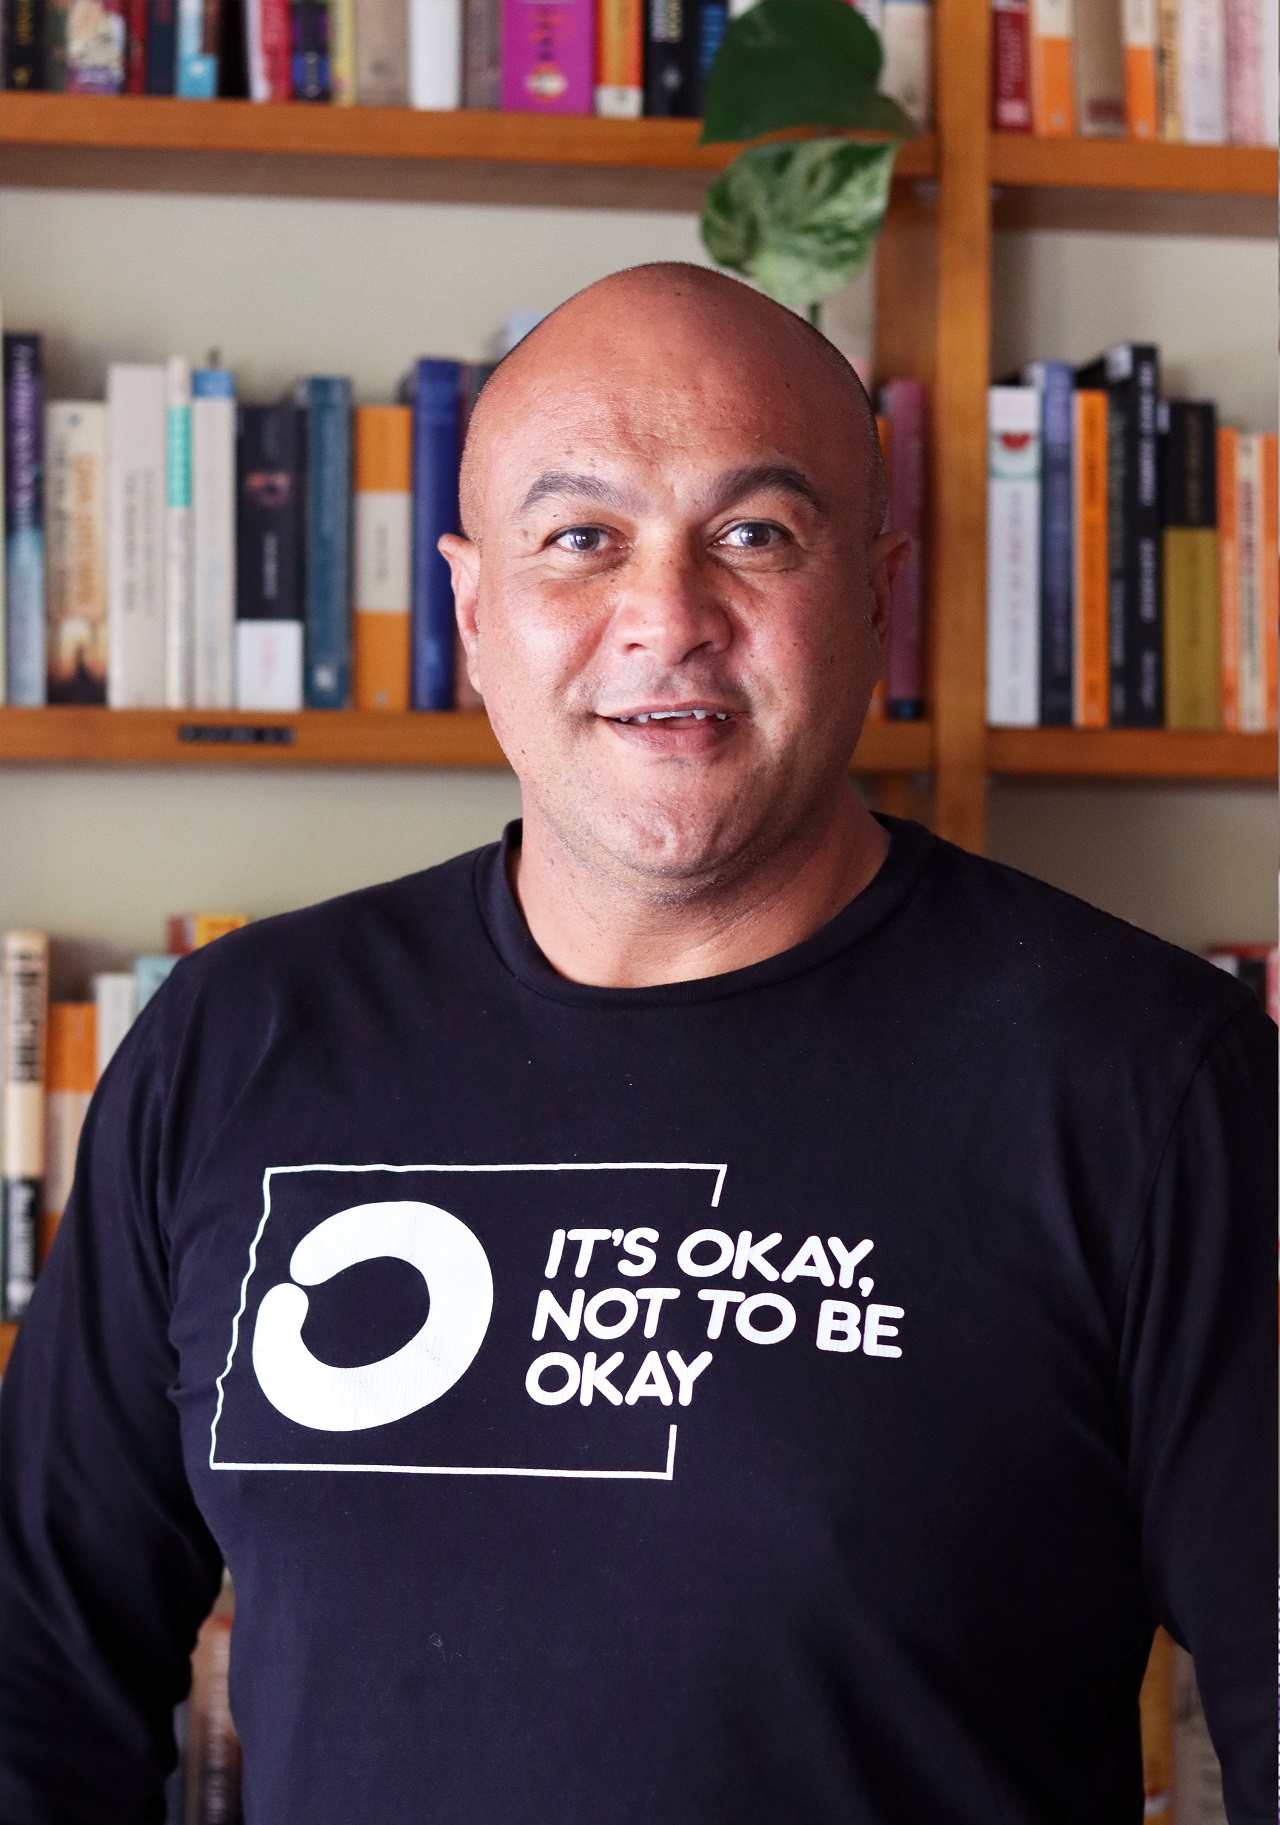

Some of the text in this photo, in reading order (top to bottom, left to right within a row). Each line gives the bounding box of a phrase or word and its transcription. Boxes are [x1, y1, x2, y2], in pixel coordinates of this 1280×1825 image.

[545, 1228, 875, 1298] IT'S OKAY,
[532, 1288, 905, 1359] NOT TO BE
[525, 1350, 713, 1407] OKAY
